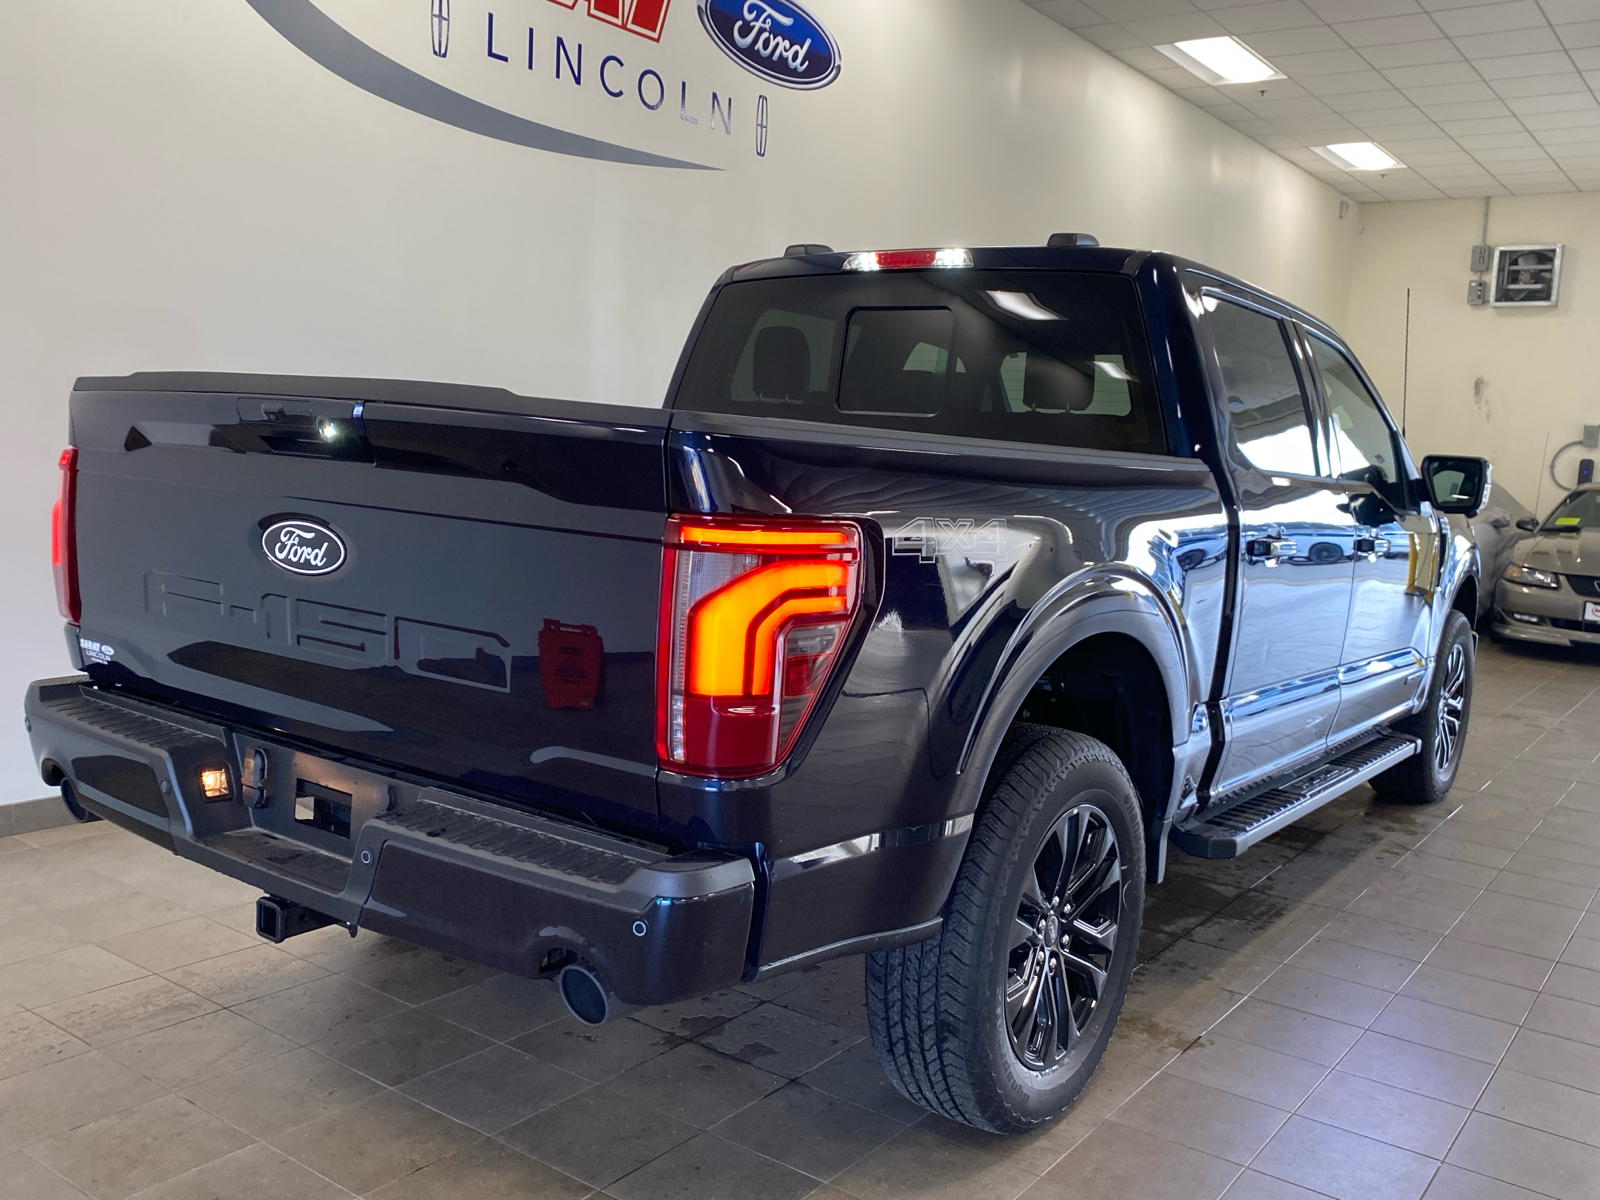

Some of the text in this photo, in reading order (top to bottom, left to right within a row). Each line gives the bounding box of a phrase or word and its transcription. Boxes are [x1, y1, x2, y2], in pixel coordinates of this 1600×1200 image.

[733, 0, 813, 73] Ford
[487, 12, 732, 135] LINCOLN
[274, 527, 329, 567] Ford
